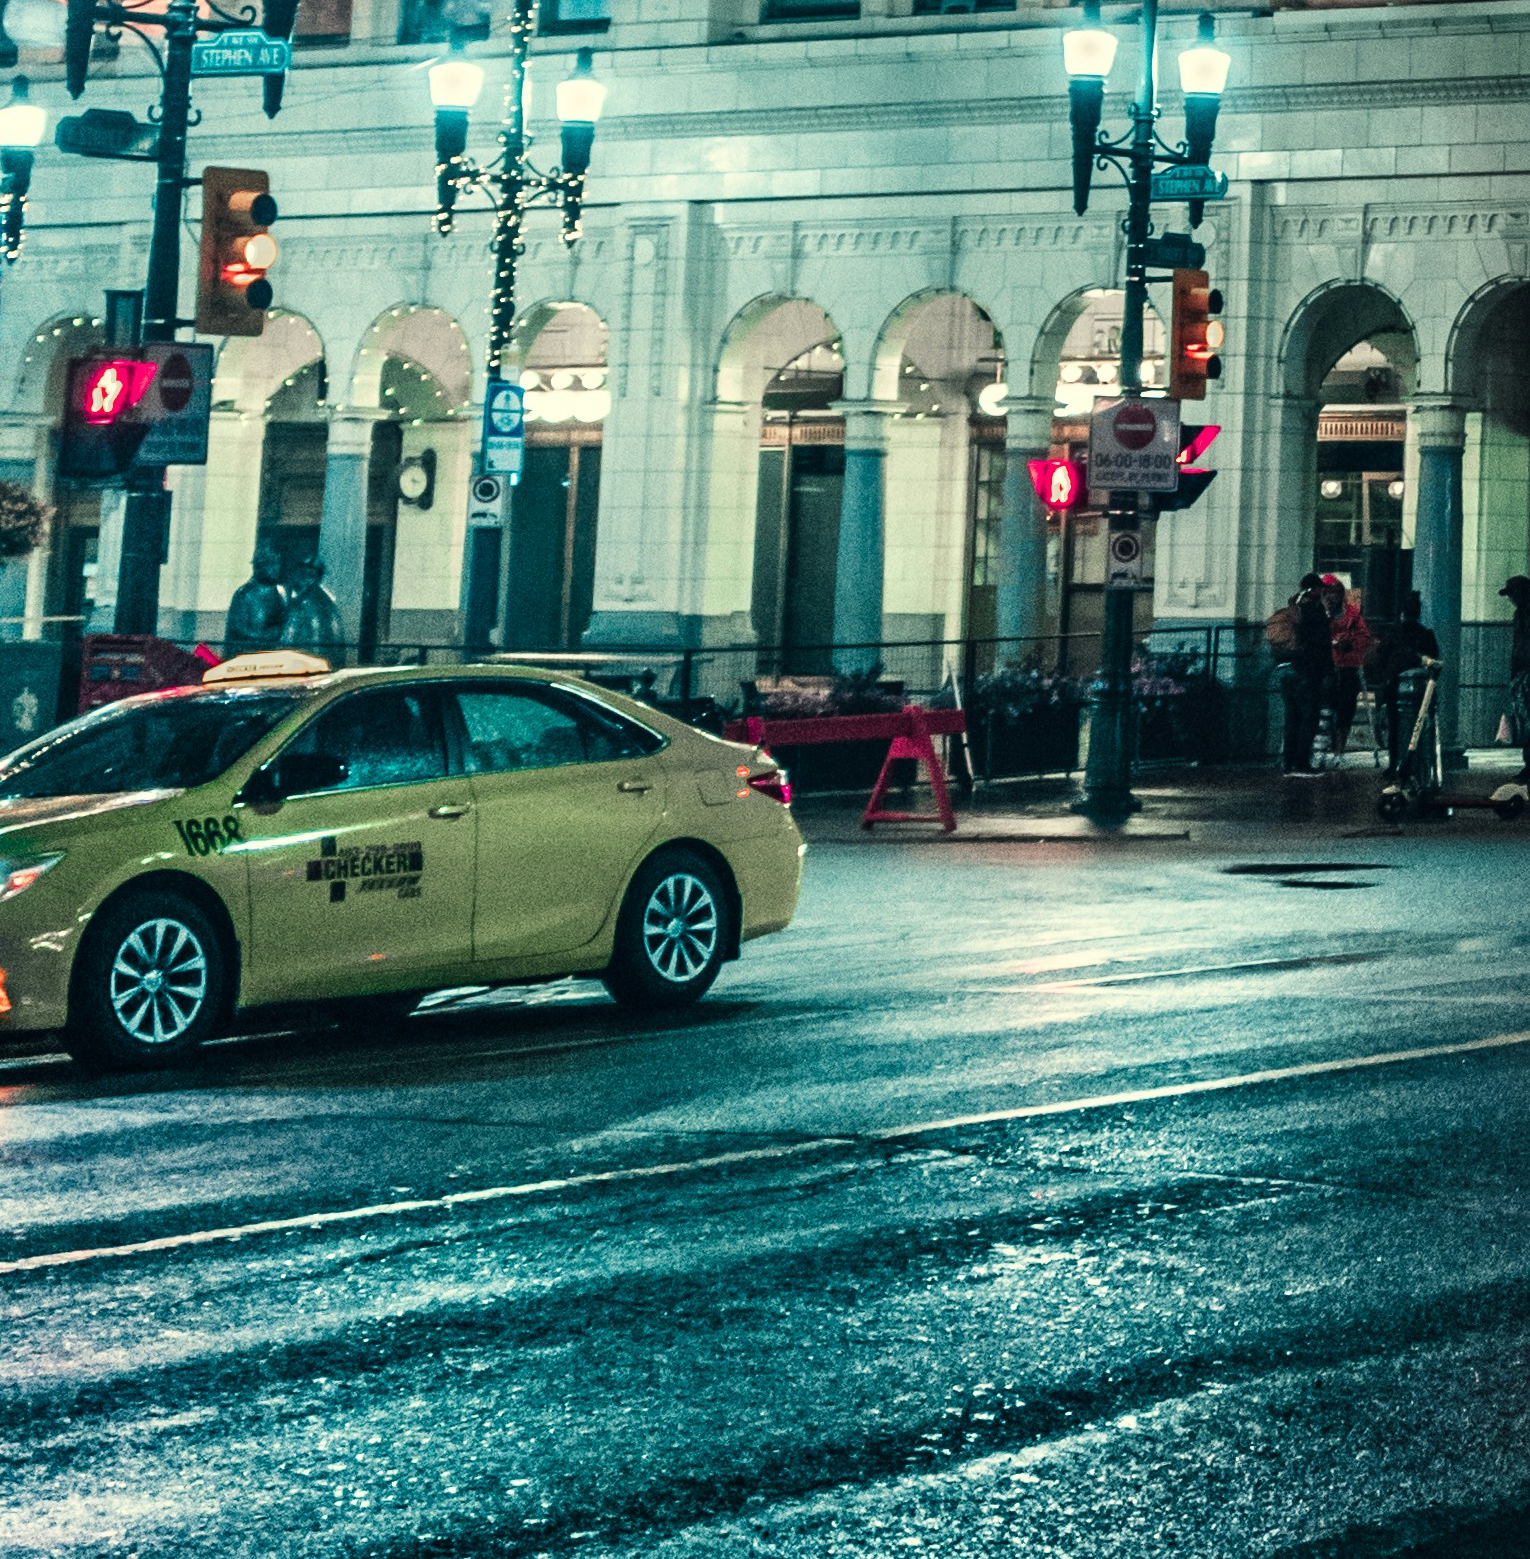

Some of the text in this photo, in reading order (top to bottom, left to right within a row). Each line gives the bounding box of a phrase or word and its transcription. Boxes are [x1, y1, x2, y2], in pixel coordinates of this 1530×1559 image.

[201, 47, 280, 68] STEPHEN AVE
[1158, 178, 1201, 194] STEPHEN
[322, 852, 408, 880] CHECKER
